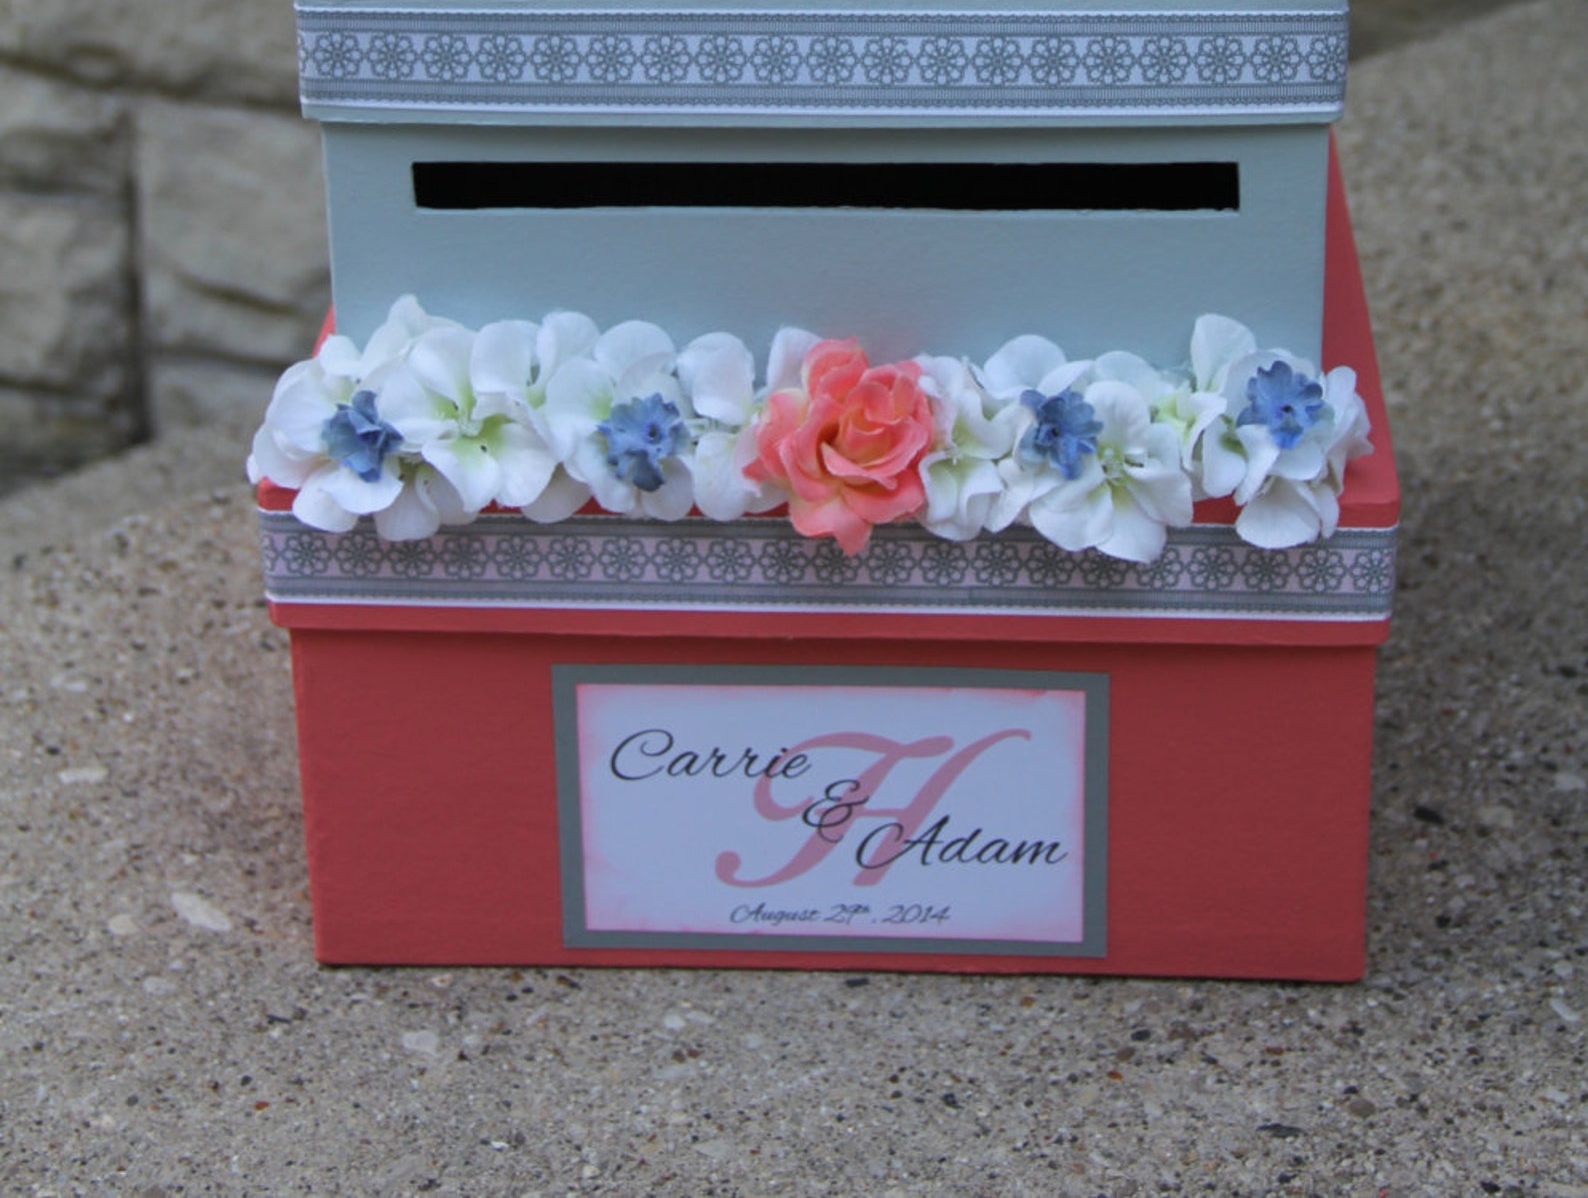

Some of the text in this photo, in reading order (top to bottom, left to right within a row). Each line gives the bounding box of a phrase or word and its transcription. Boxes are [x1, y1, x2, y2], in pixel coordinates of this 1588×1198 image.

[609, 728, 813, 782] Carrie
[715, 728, 1032, 889] H
[801, 779, 869, 843] &
[855, 815, 1068, 870] Adam
[729, 902, 821, 926] August
[881, 903, 951, 925] 2014
